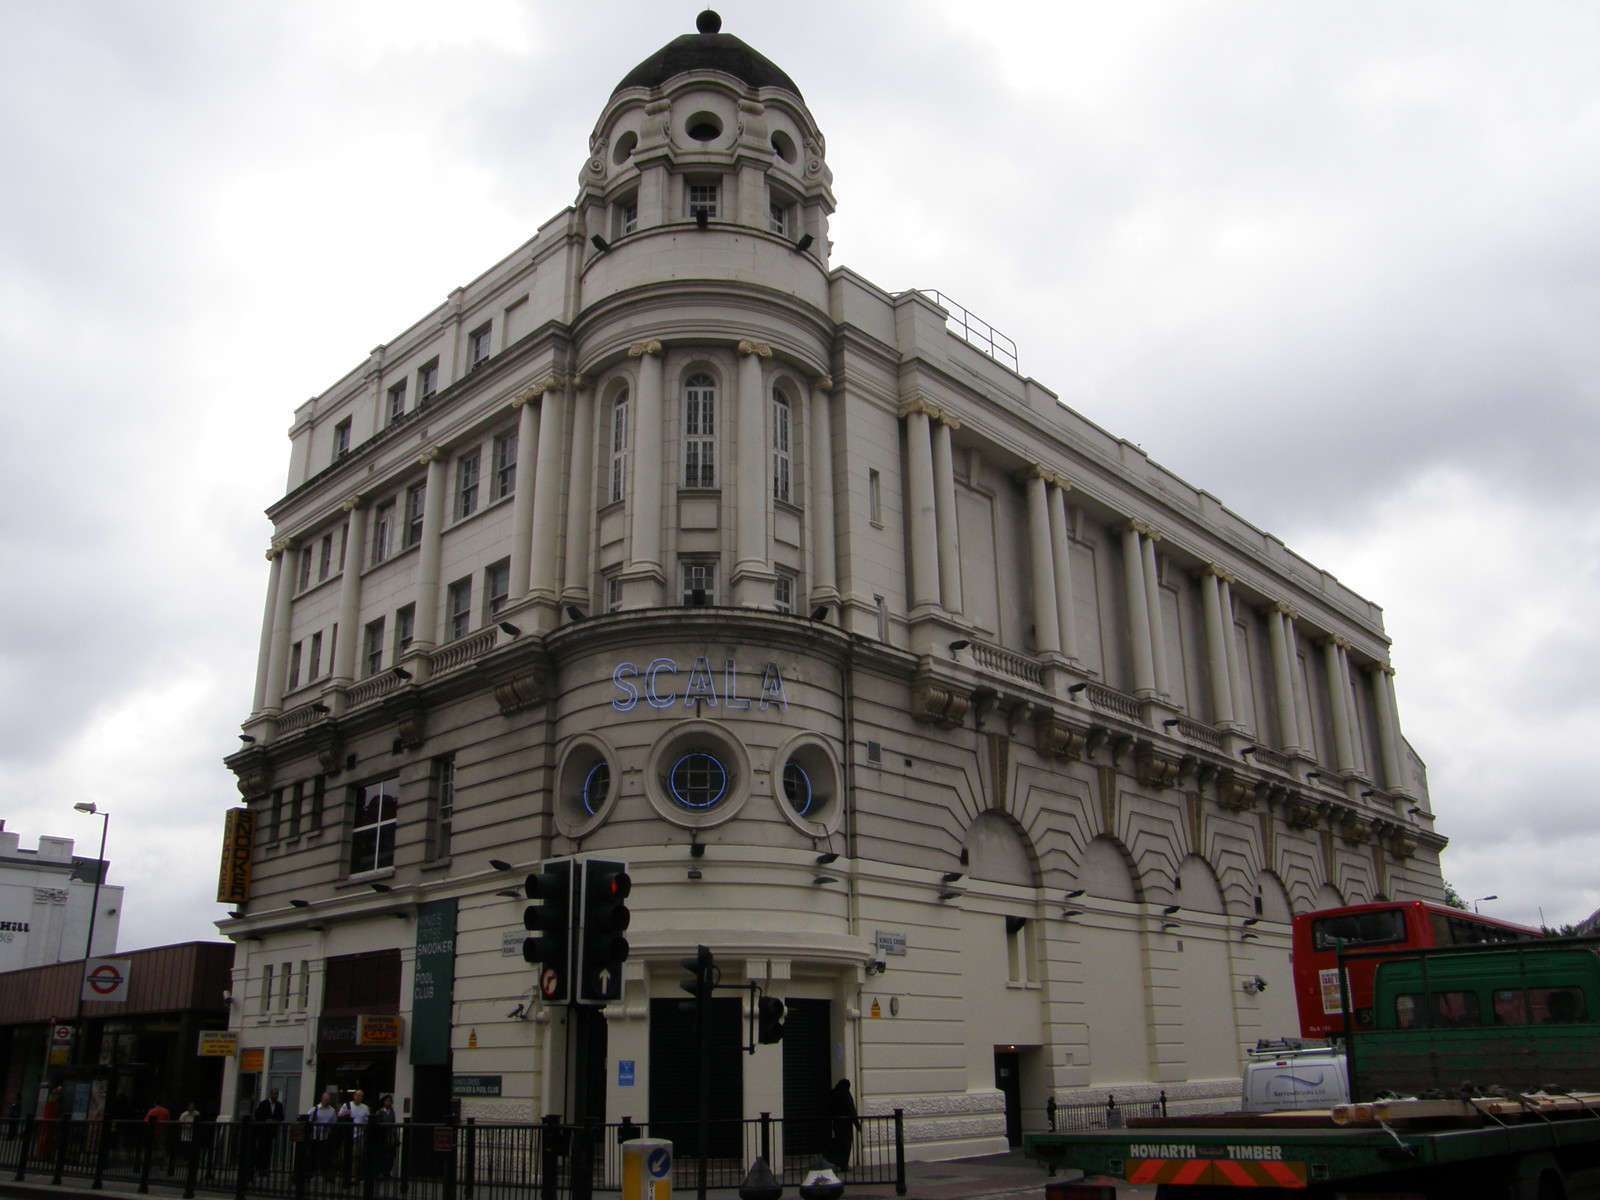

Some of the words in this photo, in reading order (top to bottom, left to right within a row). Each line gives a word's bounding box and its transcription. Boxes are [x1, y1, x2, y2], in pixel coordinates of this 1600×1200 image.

[612, 656, 788, 713] SCALA
[231, 810, 253, 898] SNOOKER
[417, 940, 453, 956] SNOOKER
[416, 958, 422, 970] &
[415, 972, 435, 985] POOL
[414, 986, 434, 1000] CLUB
[1130, 1144, 1197, 1158] HOWARTH
[1226, 1145, 1283, 1160] TIMBER
